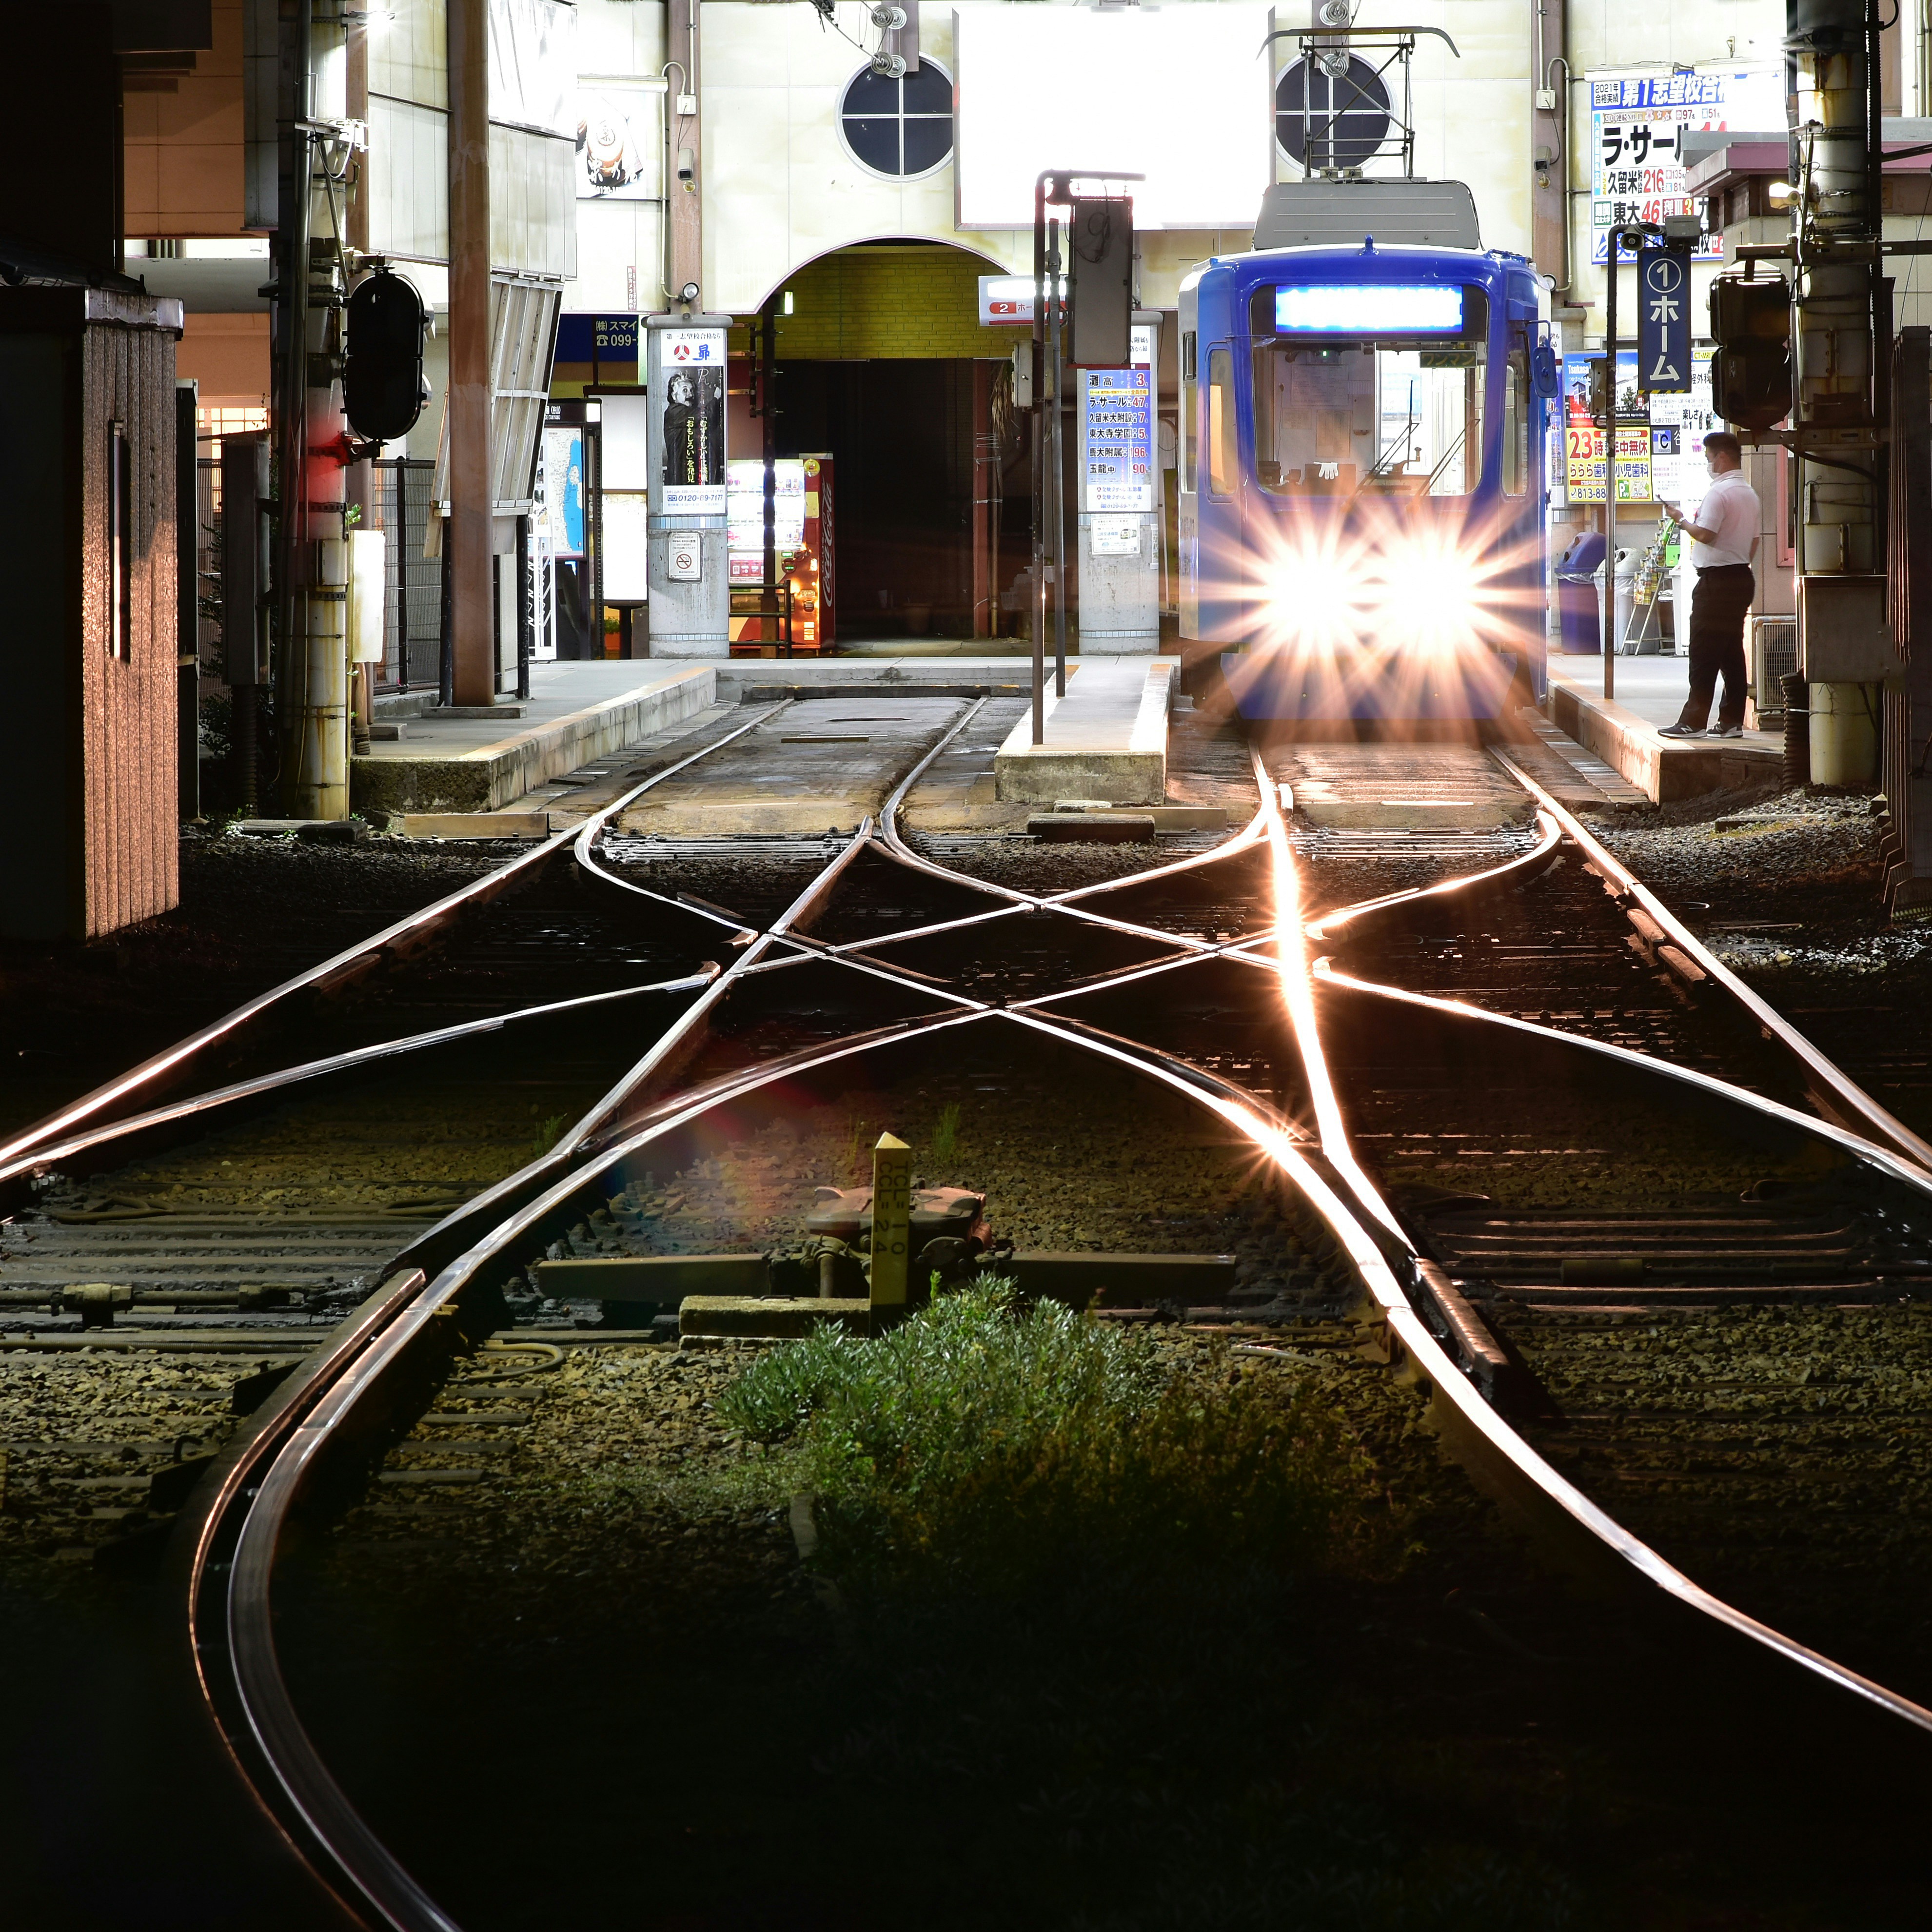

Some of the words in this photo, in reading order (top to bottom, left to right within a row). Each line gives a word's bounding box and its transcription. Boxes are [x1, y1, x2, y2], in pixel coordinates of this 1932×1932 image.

[1595, 83, 1619, 93] 2021年
[1595, 93, 1619, 104] 合格実績
[1614, 200, 1640, 225] 東大
[1018, 303, 1033, 312] ホー
[611, 334, 639, 347] 099-
[1420, 352, 1476, 366] ワンマン
